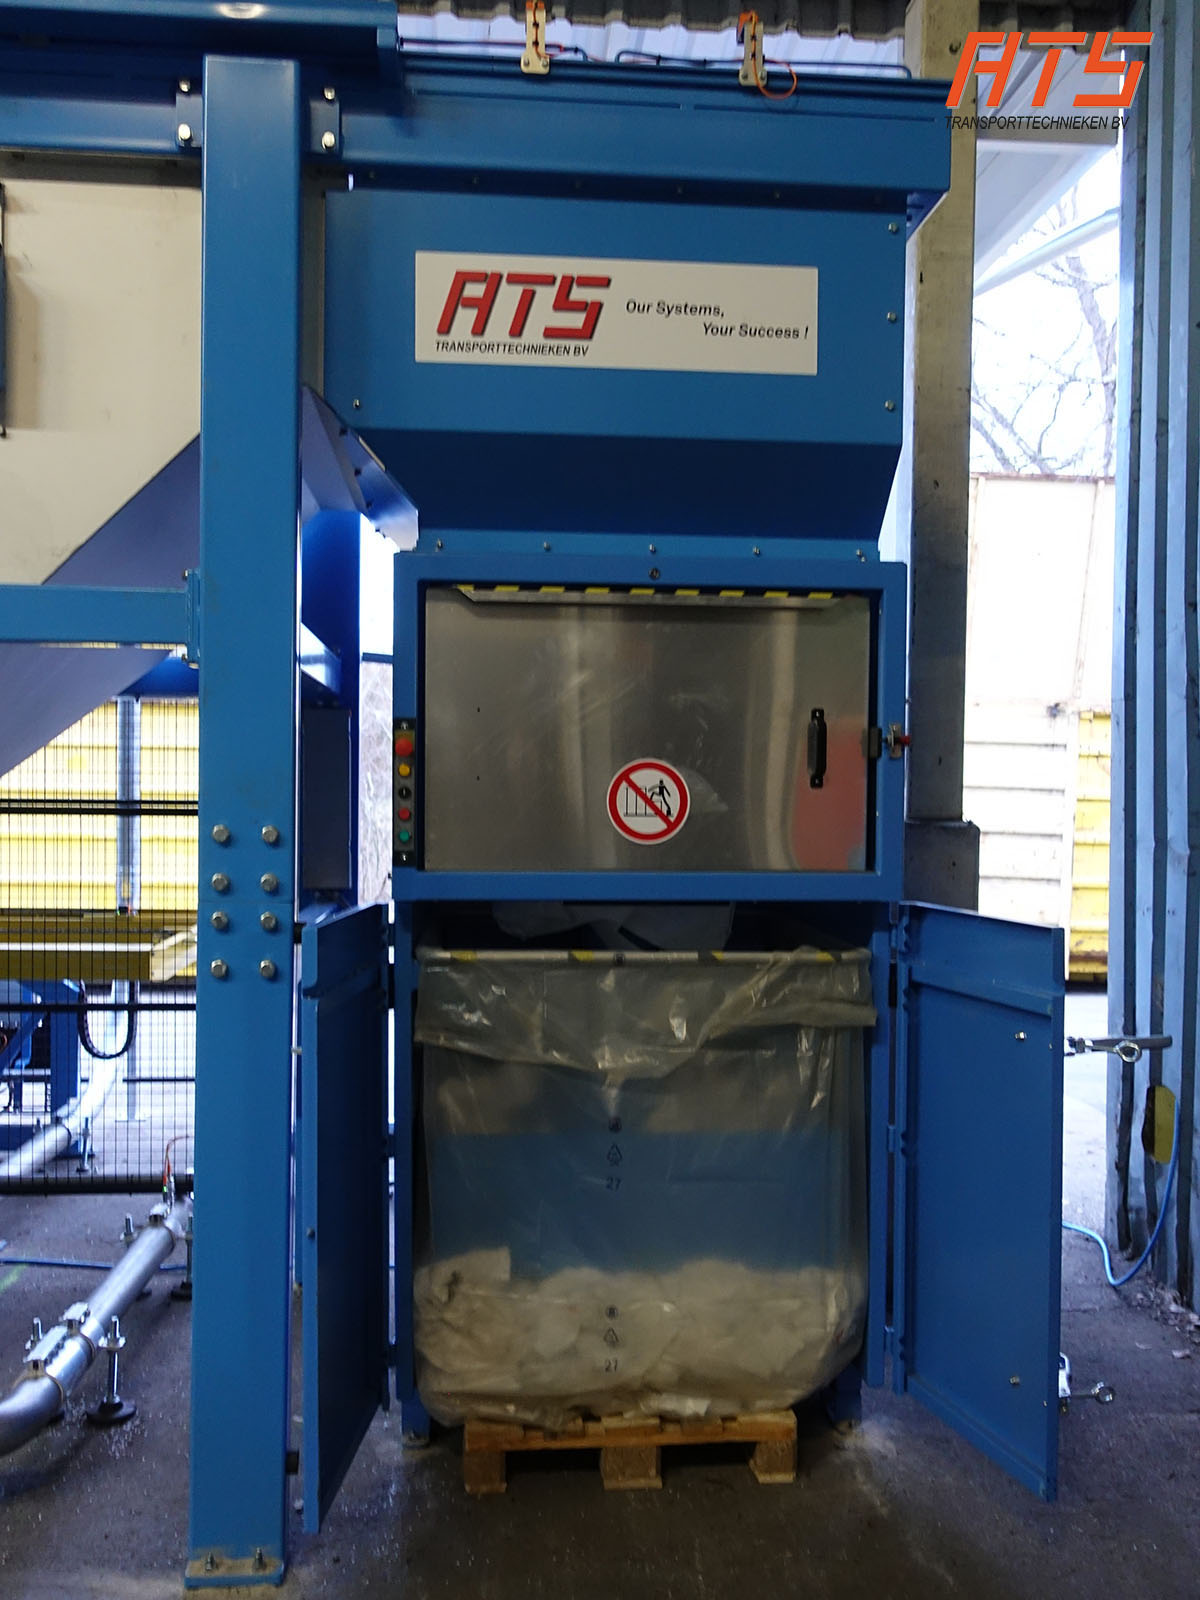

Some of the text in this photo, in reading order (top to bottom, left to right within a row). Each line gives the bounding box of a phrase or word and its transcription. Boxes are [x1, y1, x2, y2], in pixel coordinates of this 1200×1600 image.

[436, 270, 612, 341] ATS
[626, 300, 725, 318] Our Systems,
[703, 323, 736, 337] Your
[739, 325, 800, 340] Success
[435, 341, 590, 357] TRANSPORTTECHNIEKEN BV
